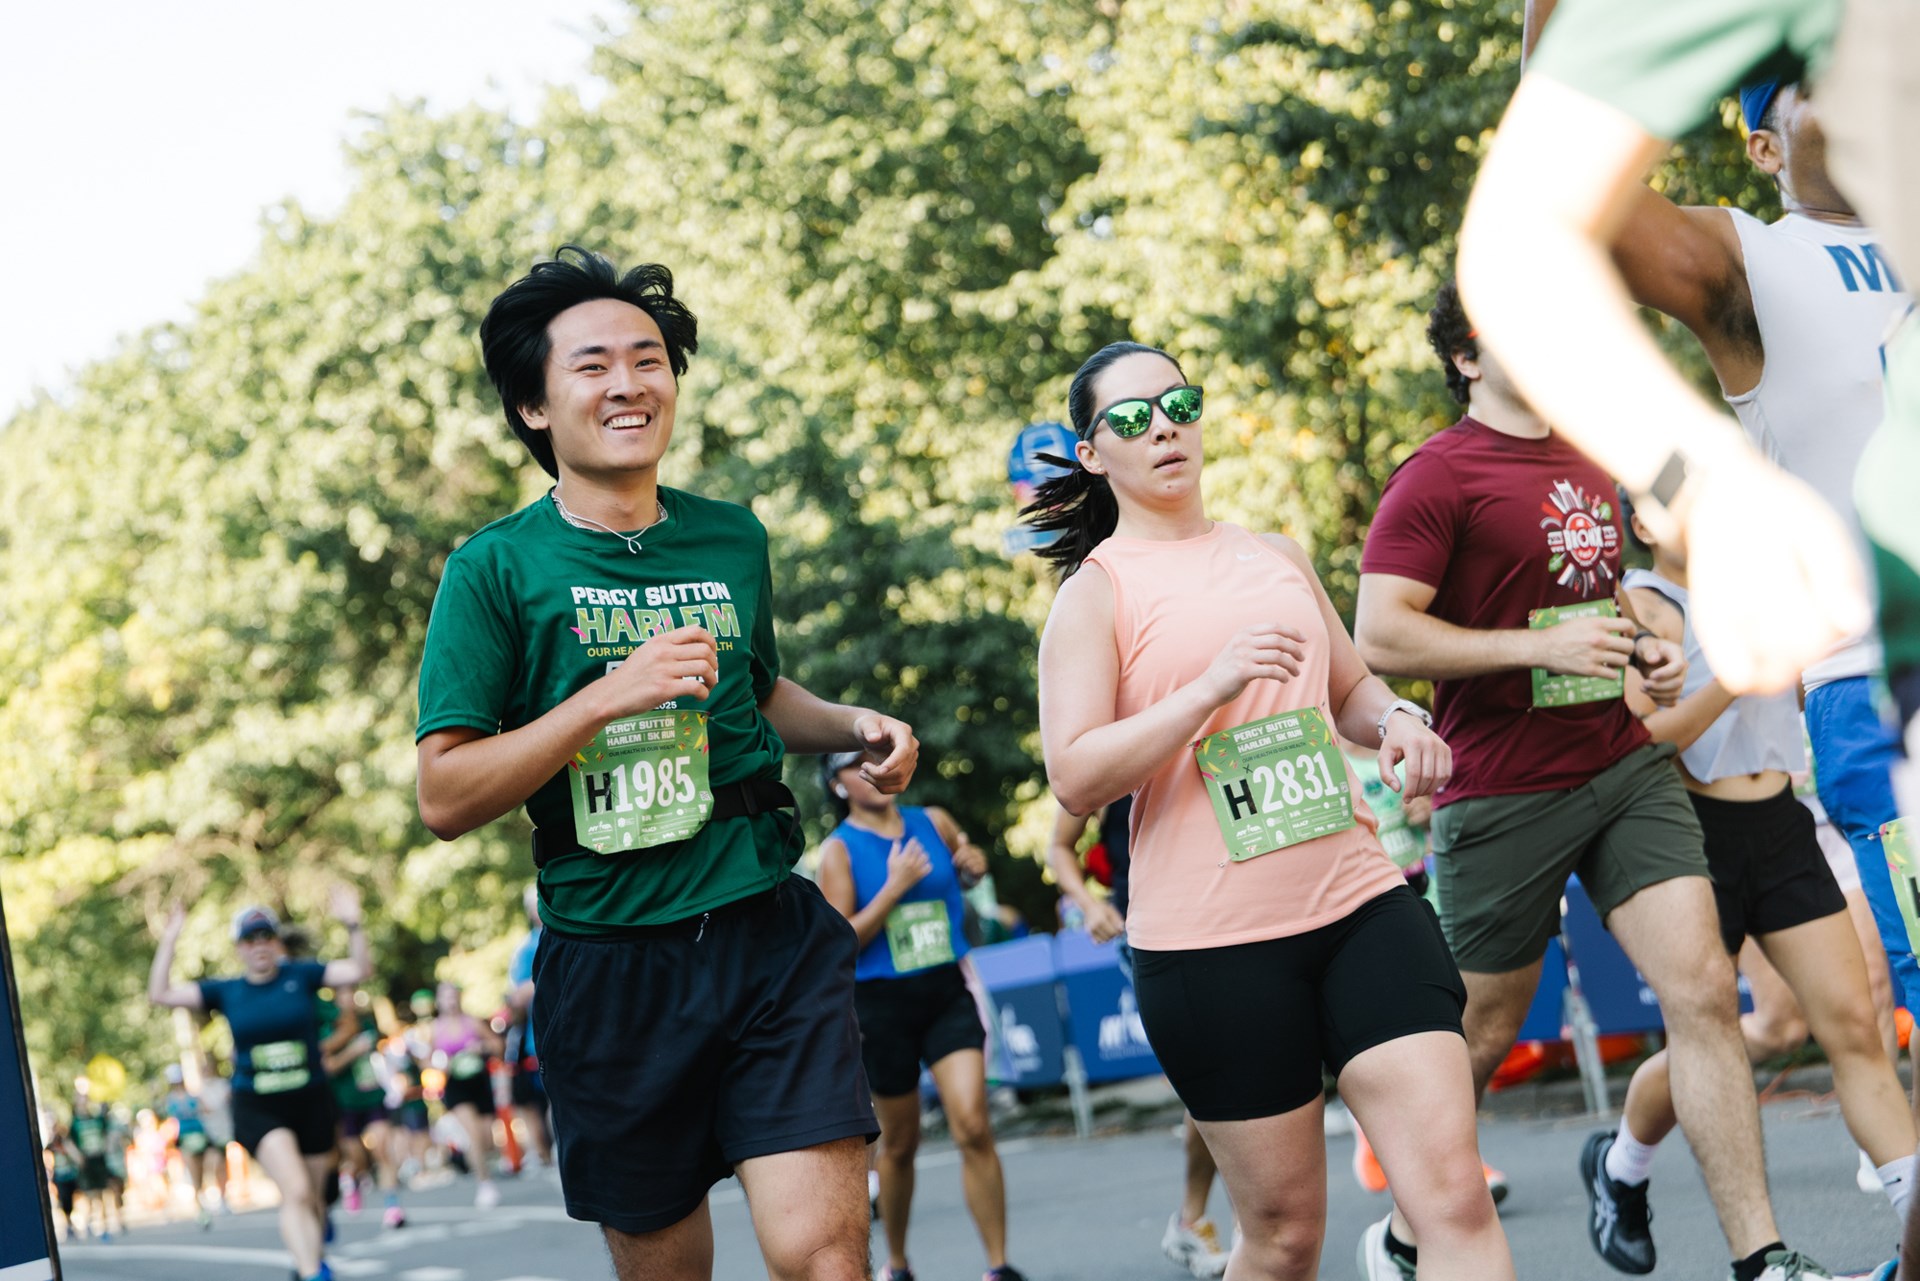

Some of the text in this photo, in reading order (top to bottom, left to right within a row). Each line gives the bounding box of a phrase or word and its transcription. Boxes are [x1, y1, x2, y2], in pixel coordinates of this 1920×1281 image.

[570, 581, 731, 606] PERCY SUTTON
[587, 647, 611, 657] OUR
[605, 717, 675, 735] PERCY SUTTON
[1234, 718, 1299, 742] PERCY SUTTON
[606, 729, 675, 747] HARLEM 5K RUN
[1237, 729, 1303, 753] HARLEM 5K RUN
